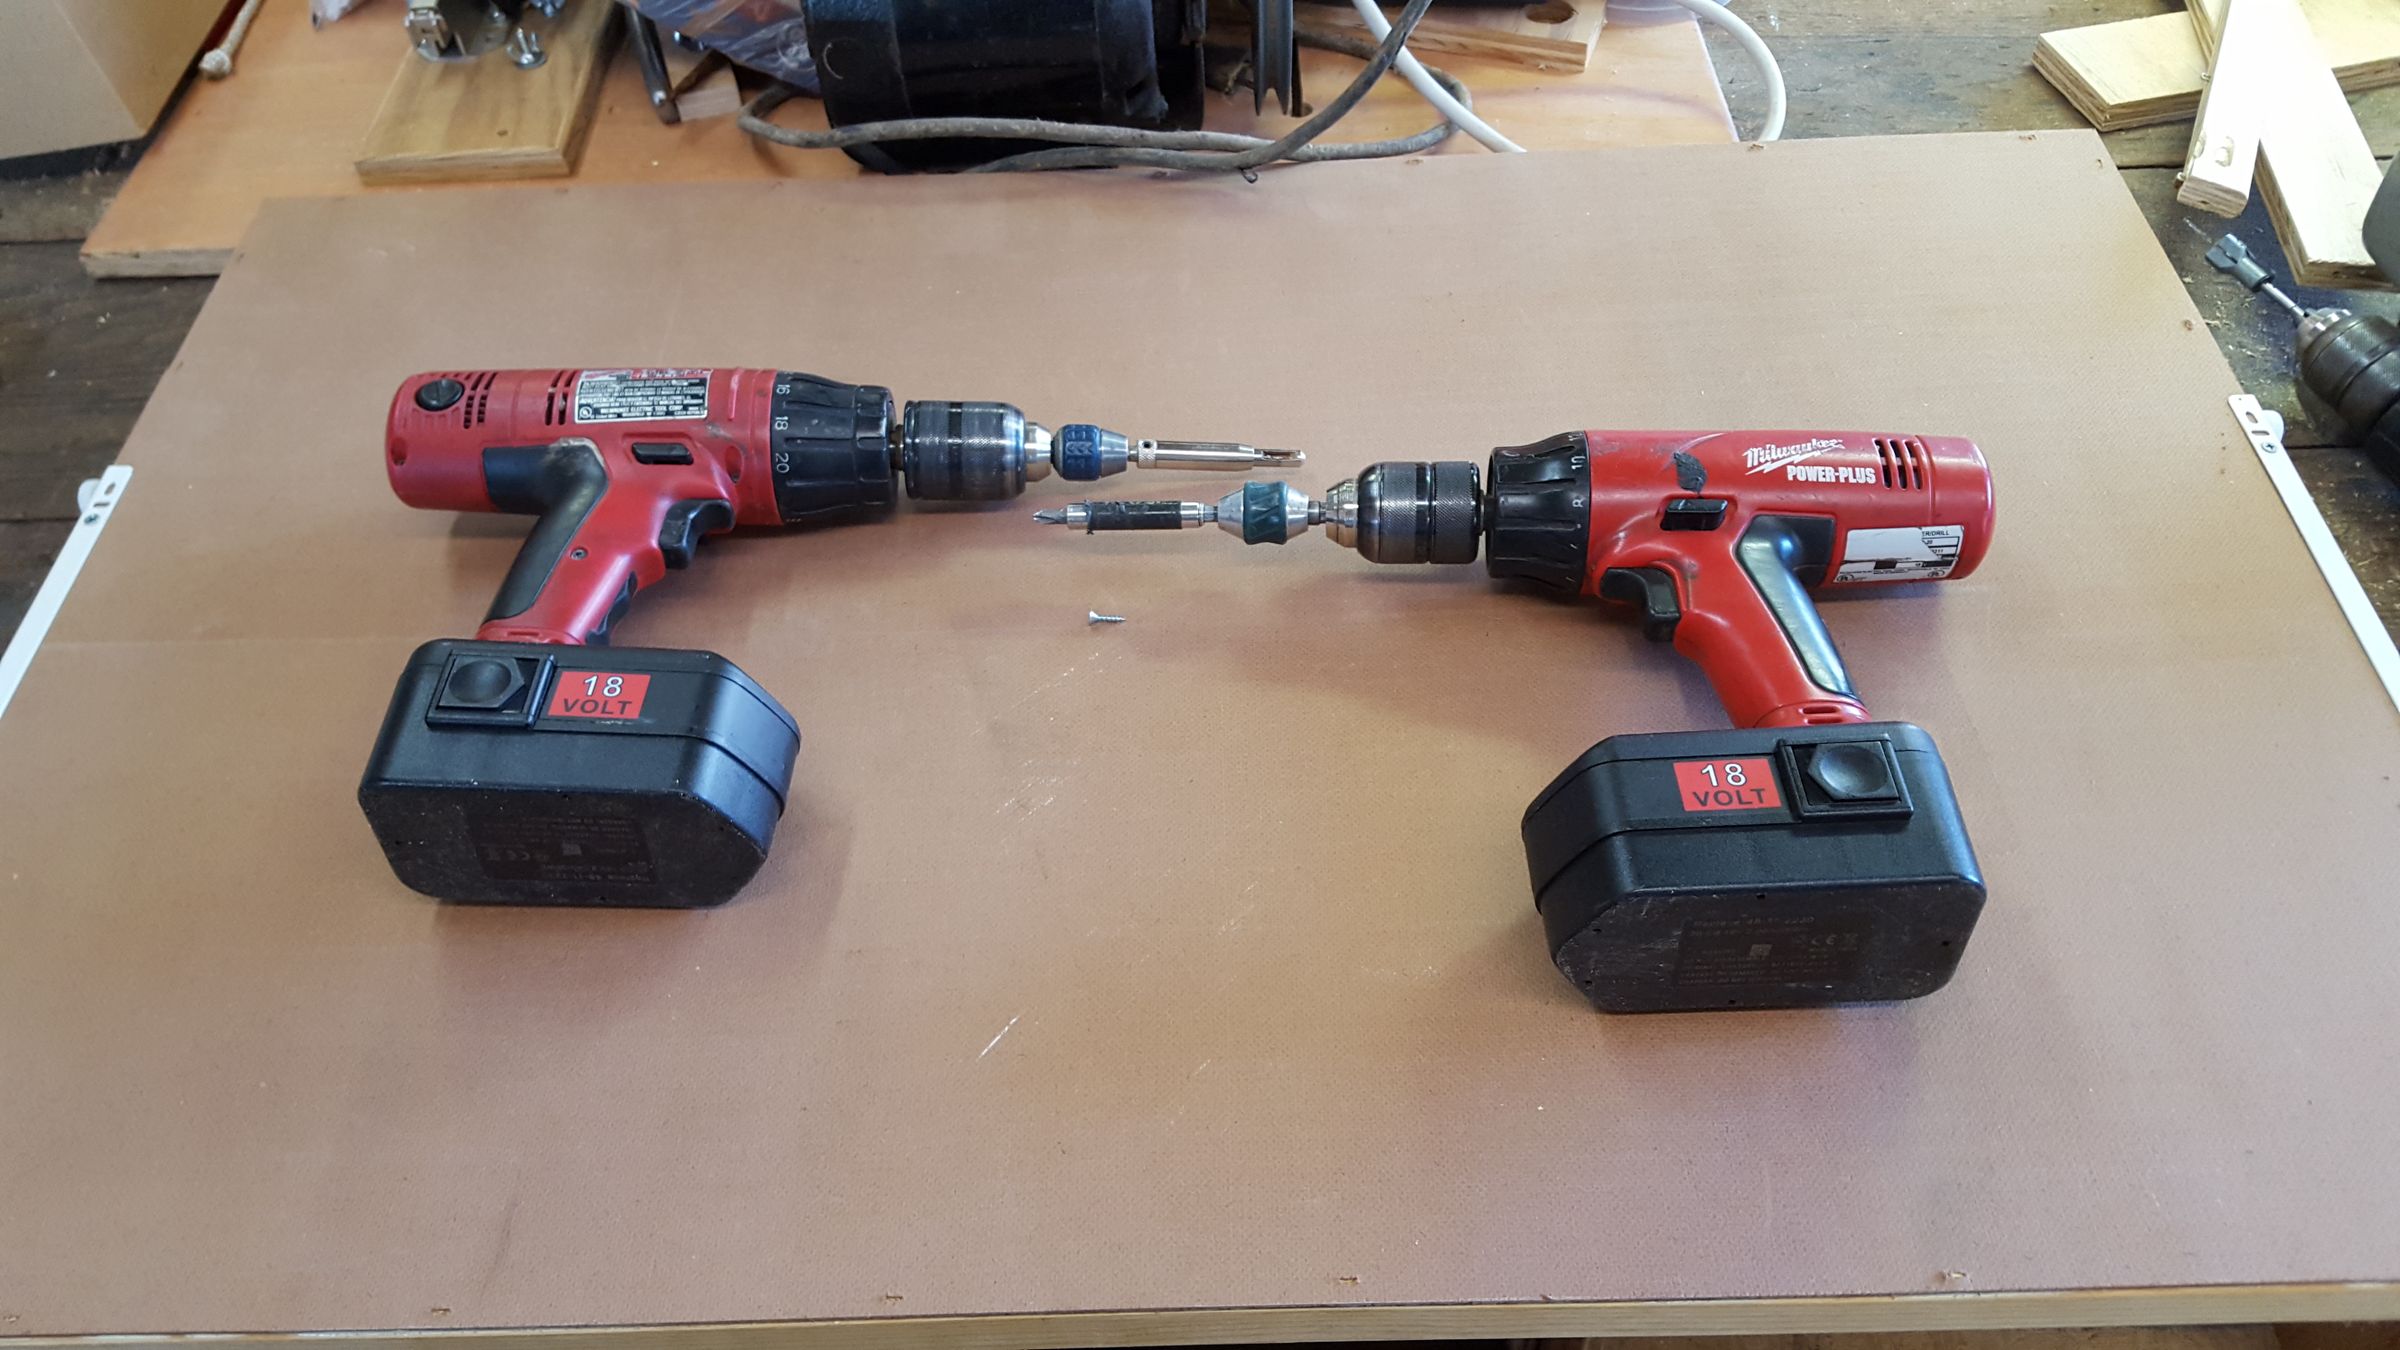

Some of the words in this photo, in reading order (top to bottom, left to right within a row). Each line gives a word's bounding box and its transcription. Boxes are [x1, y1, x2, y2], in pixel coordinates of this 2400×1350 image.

[776, 384, 791, 395] 16
[775, 416, 789, 431] 18
[1742, 438, 1843, 468] Milwaukee
[775, 453, 789, 473] 20
[1786, 465, 1876, 484] POWER-PLUS
[583, 674, 624, 698] 18
[563, 699, 632, 715] VOLT
[1701, 763, 1748, 787] 18
[1692, 788, 1765, 807] VOLT
